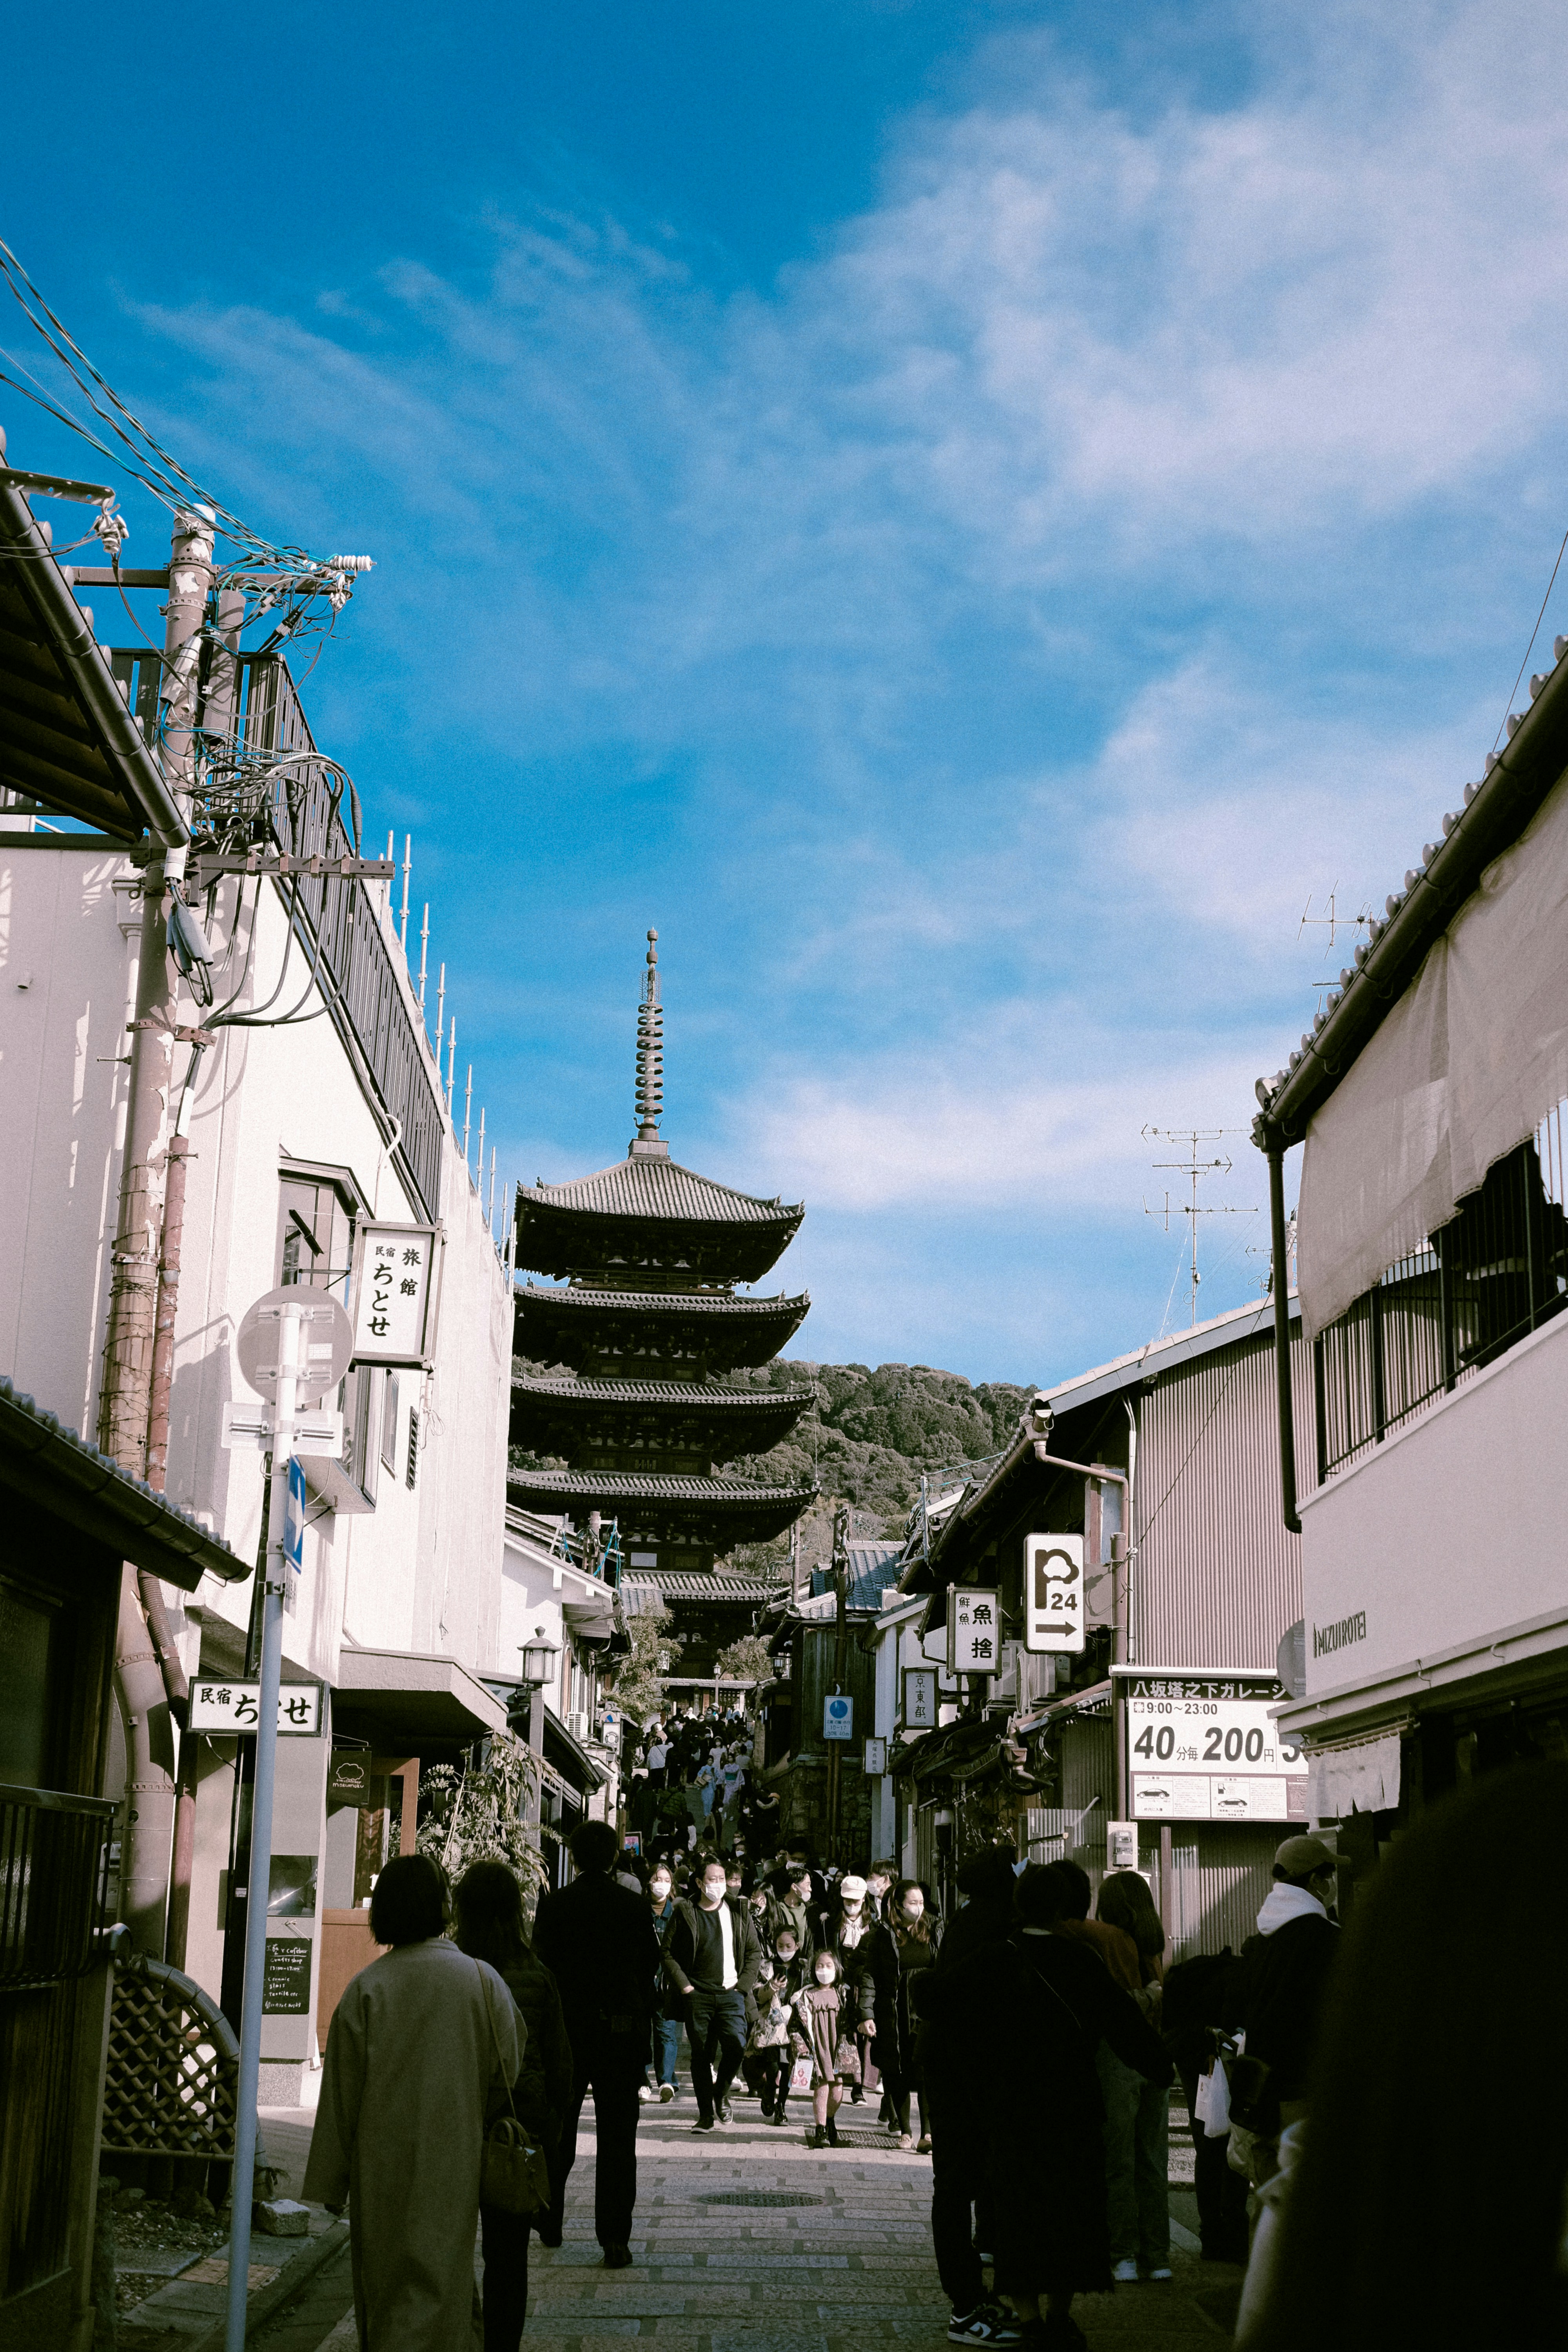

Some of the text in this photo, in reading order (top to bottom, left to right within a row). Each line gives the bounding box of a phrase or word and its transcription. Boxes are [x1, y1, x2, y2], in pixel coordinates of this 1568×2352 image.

[375, 1246, 396, 1258] 民宿
[400, 1248, 422, 1296] 旅館
[367, 1263, 393, 1336] ちとせ
[958, 1597, 970, 1625] 鮮魚
[1051, 1593, 1077, 1611] 24
[971, 1604, 993, 1659] 魚捨
[1318, 1610, 1366, 1657] MIZUIROTEI
[200, 1688, 312, 1724] 民宿 ちせ
[915, 1674, 926, 1719] 京東都
[1134, 1726, 1274, 1762] 40 分毎 200 円
